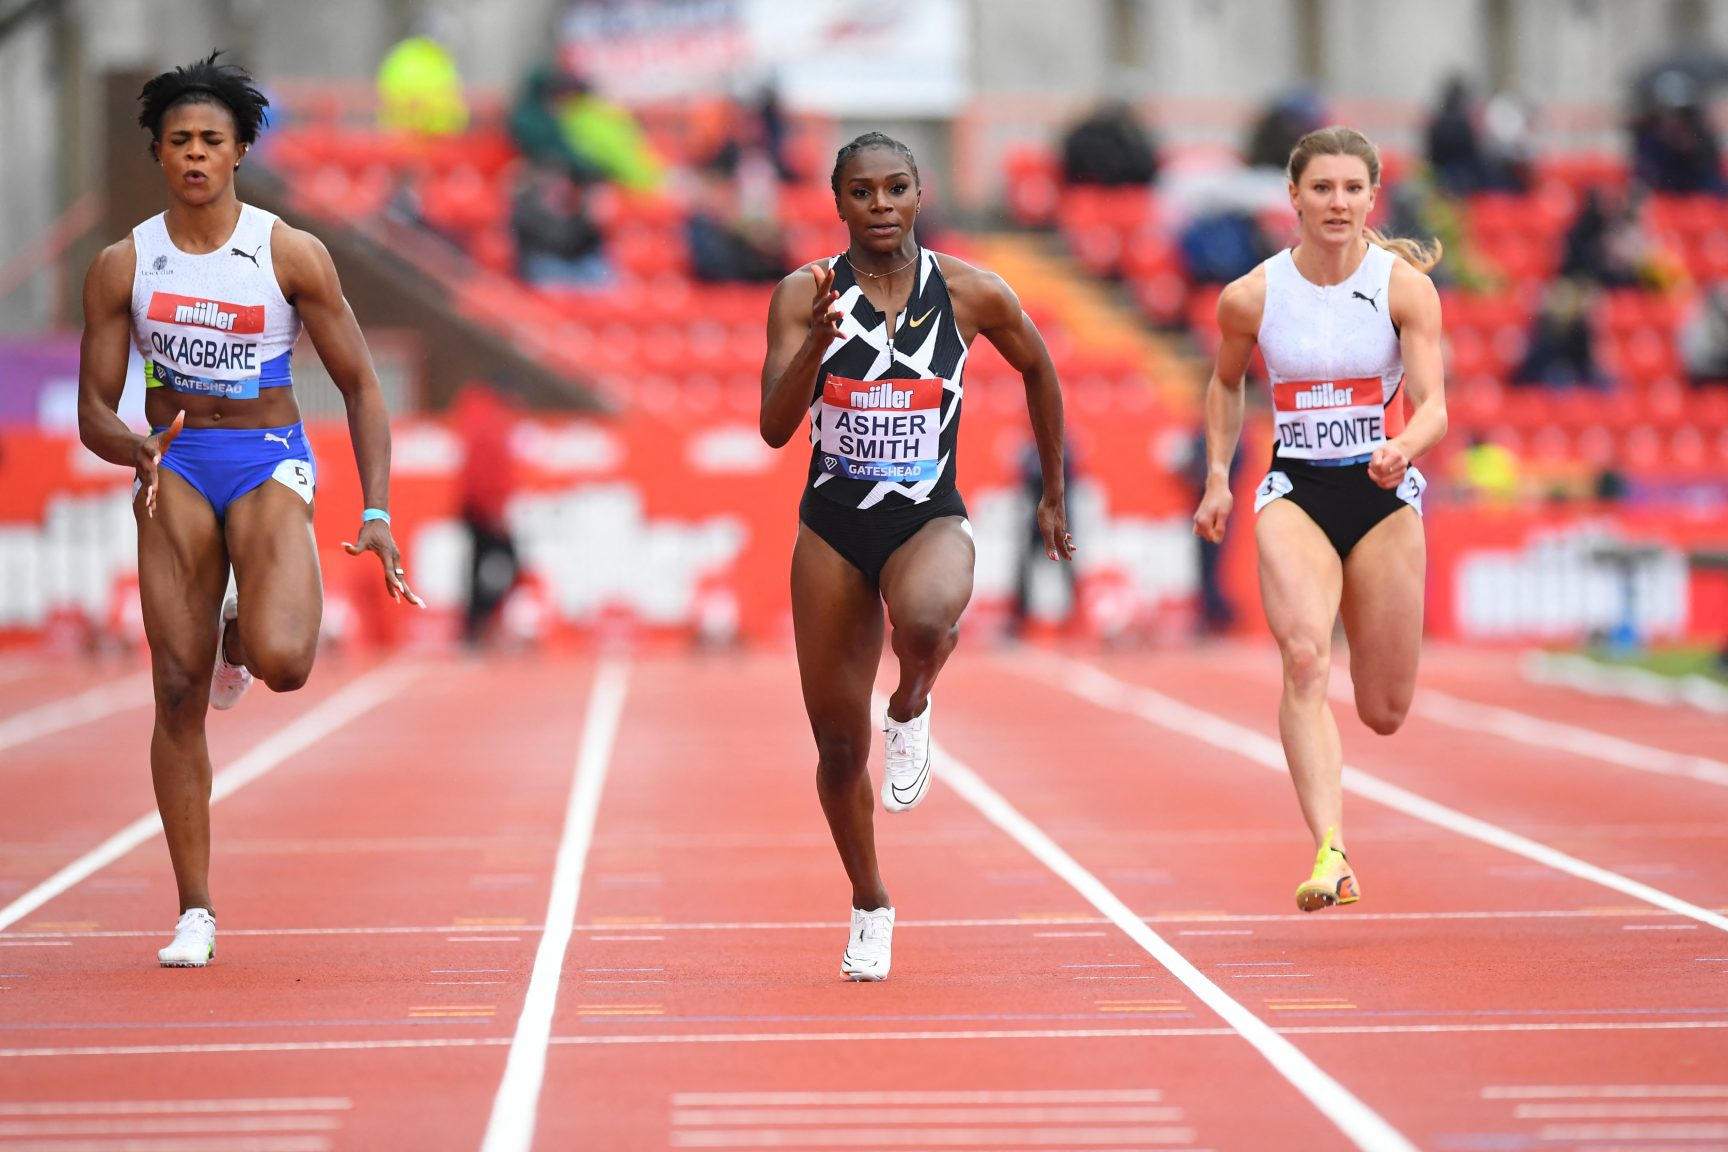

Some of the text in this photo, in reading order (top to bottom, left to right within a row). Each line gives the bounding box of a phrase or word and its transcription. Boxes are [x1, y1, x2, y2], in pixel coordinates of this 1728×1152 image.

[175, 302, 238, 331] müller
[151, 332, 257, 370] OKAGBARE
[174, 376, 243, 394] GATESHEAD
[850, 383, 914, 409] müller
[1295, 383, 1354, 409] müller
[835, 411, 926, 436] ASHER
[1279, 417, 1381, 449] DEL PONTE
[839, 435, 920, 459] SMITH
[294, 466, 308, 486] 5
[848, 464, 922, 477] GATESHEAD
[1262, 477, 1273, 496] 3
[1409, 476, 1420, 498] 3
